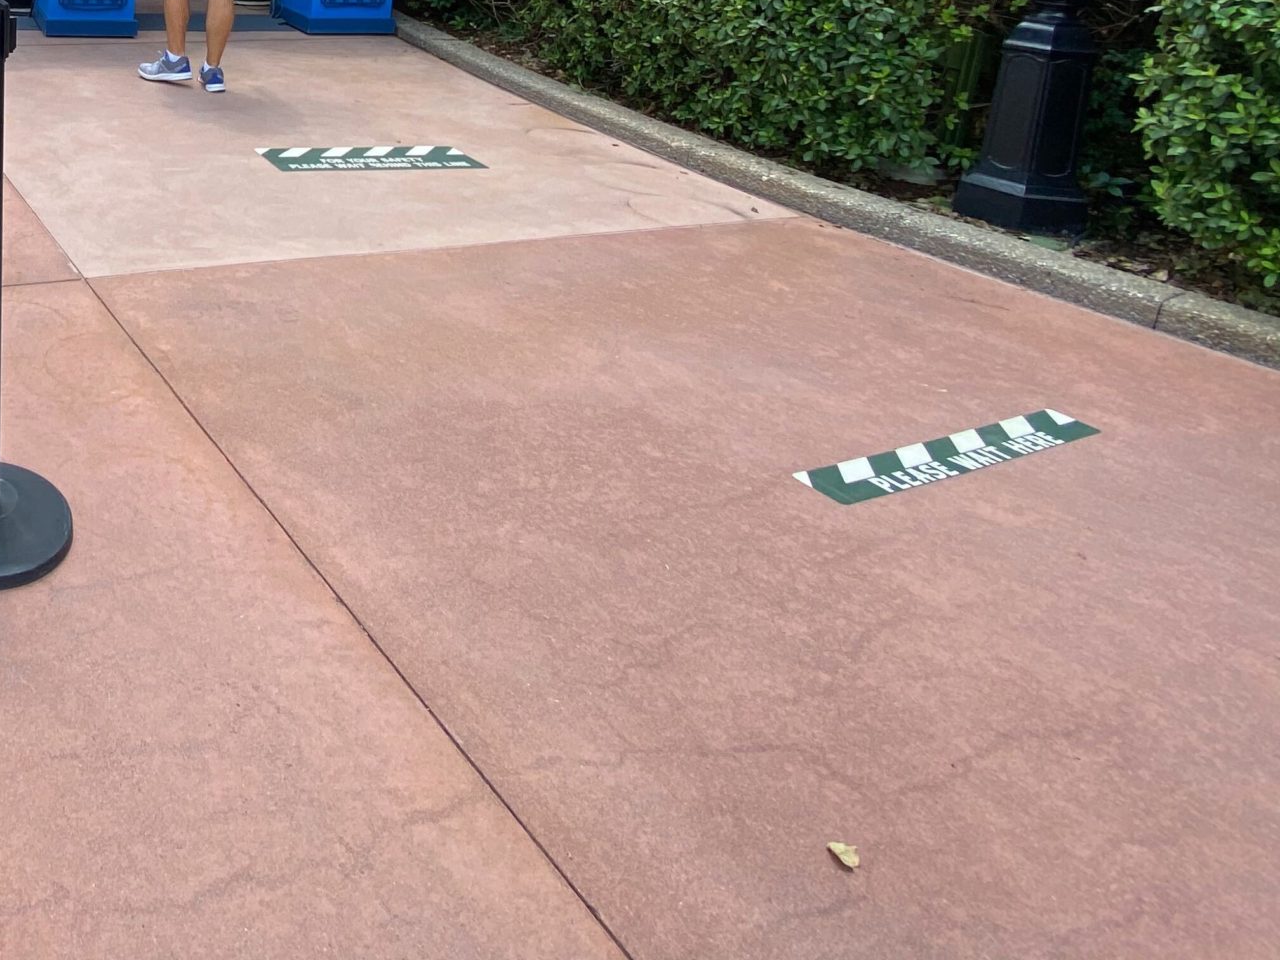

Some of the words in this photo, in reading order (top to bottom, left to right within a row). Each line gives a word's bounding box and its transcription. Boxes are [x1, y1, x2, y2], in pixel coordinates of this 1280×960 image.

[867, 461, 960, 493] PLEASE
[947, 445, 1012, 471] WAIT
[1002, 431, 1065, 455] HERE
